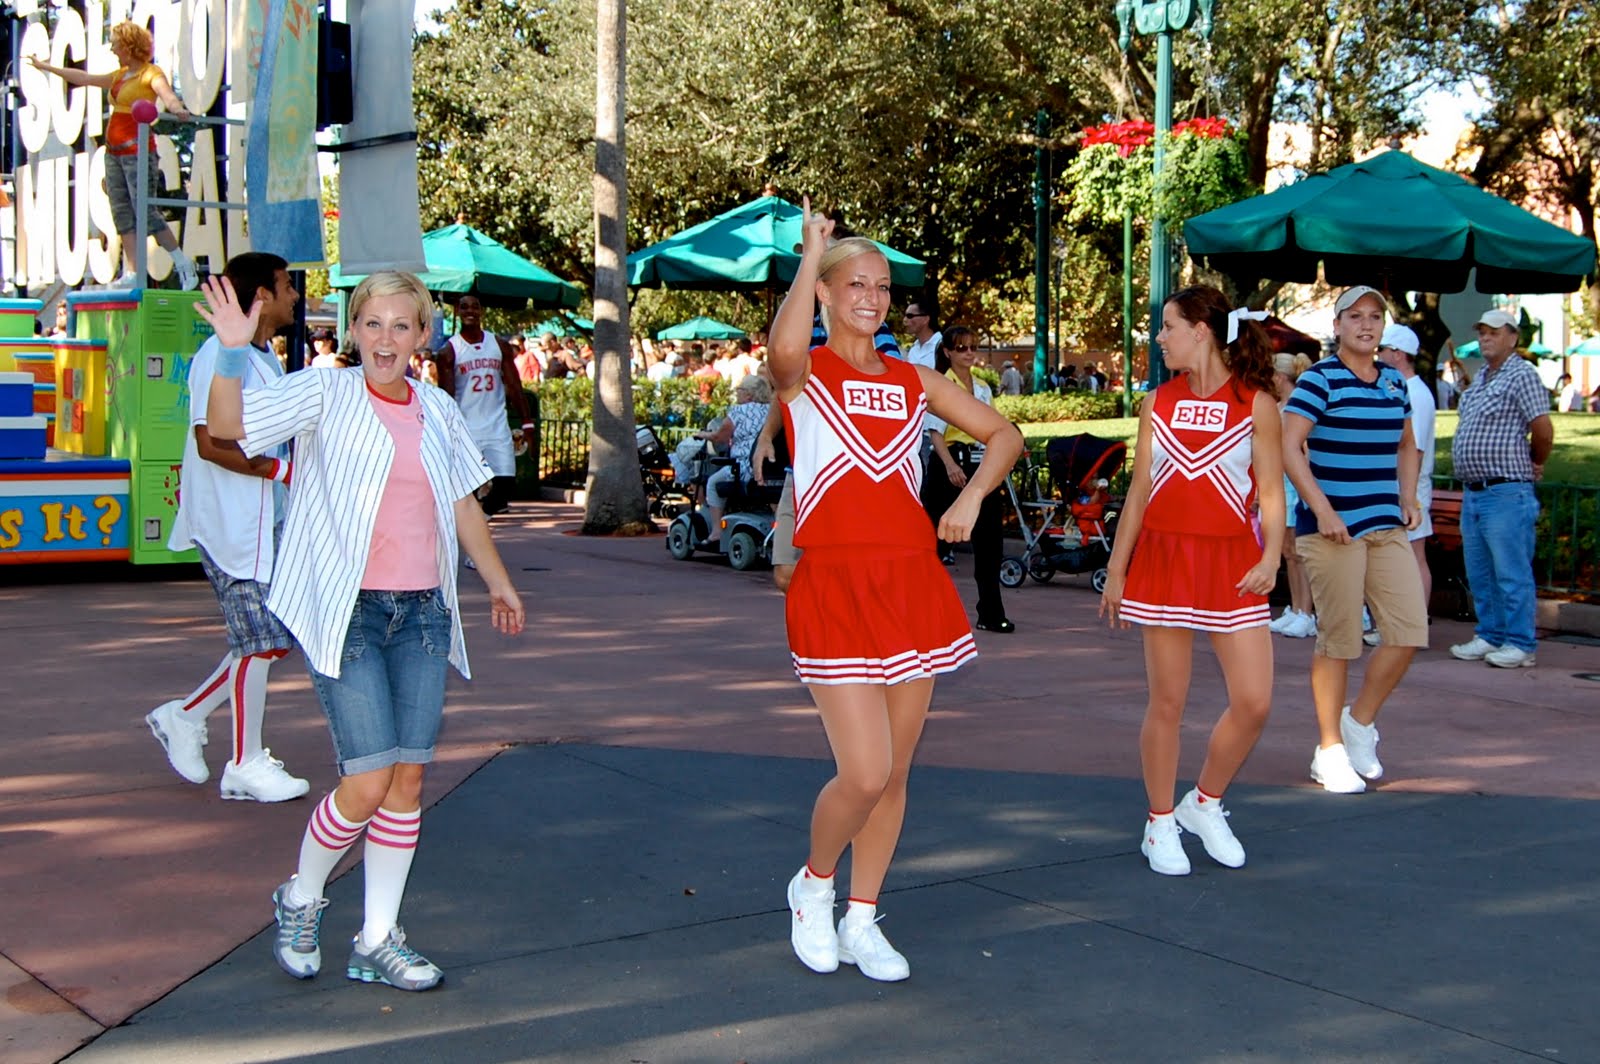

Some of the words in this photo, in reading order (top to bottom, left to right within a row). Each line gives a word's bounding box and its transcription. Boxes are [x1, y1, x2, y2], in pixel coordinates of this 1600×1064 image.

[15, 120, 251, 287] MUSCAL
[471, 373, 494, 392] 23
[846, 387, 904, 412] EHS
[1175, 405, 1225, 426] EHS
